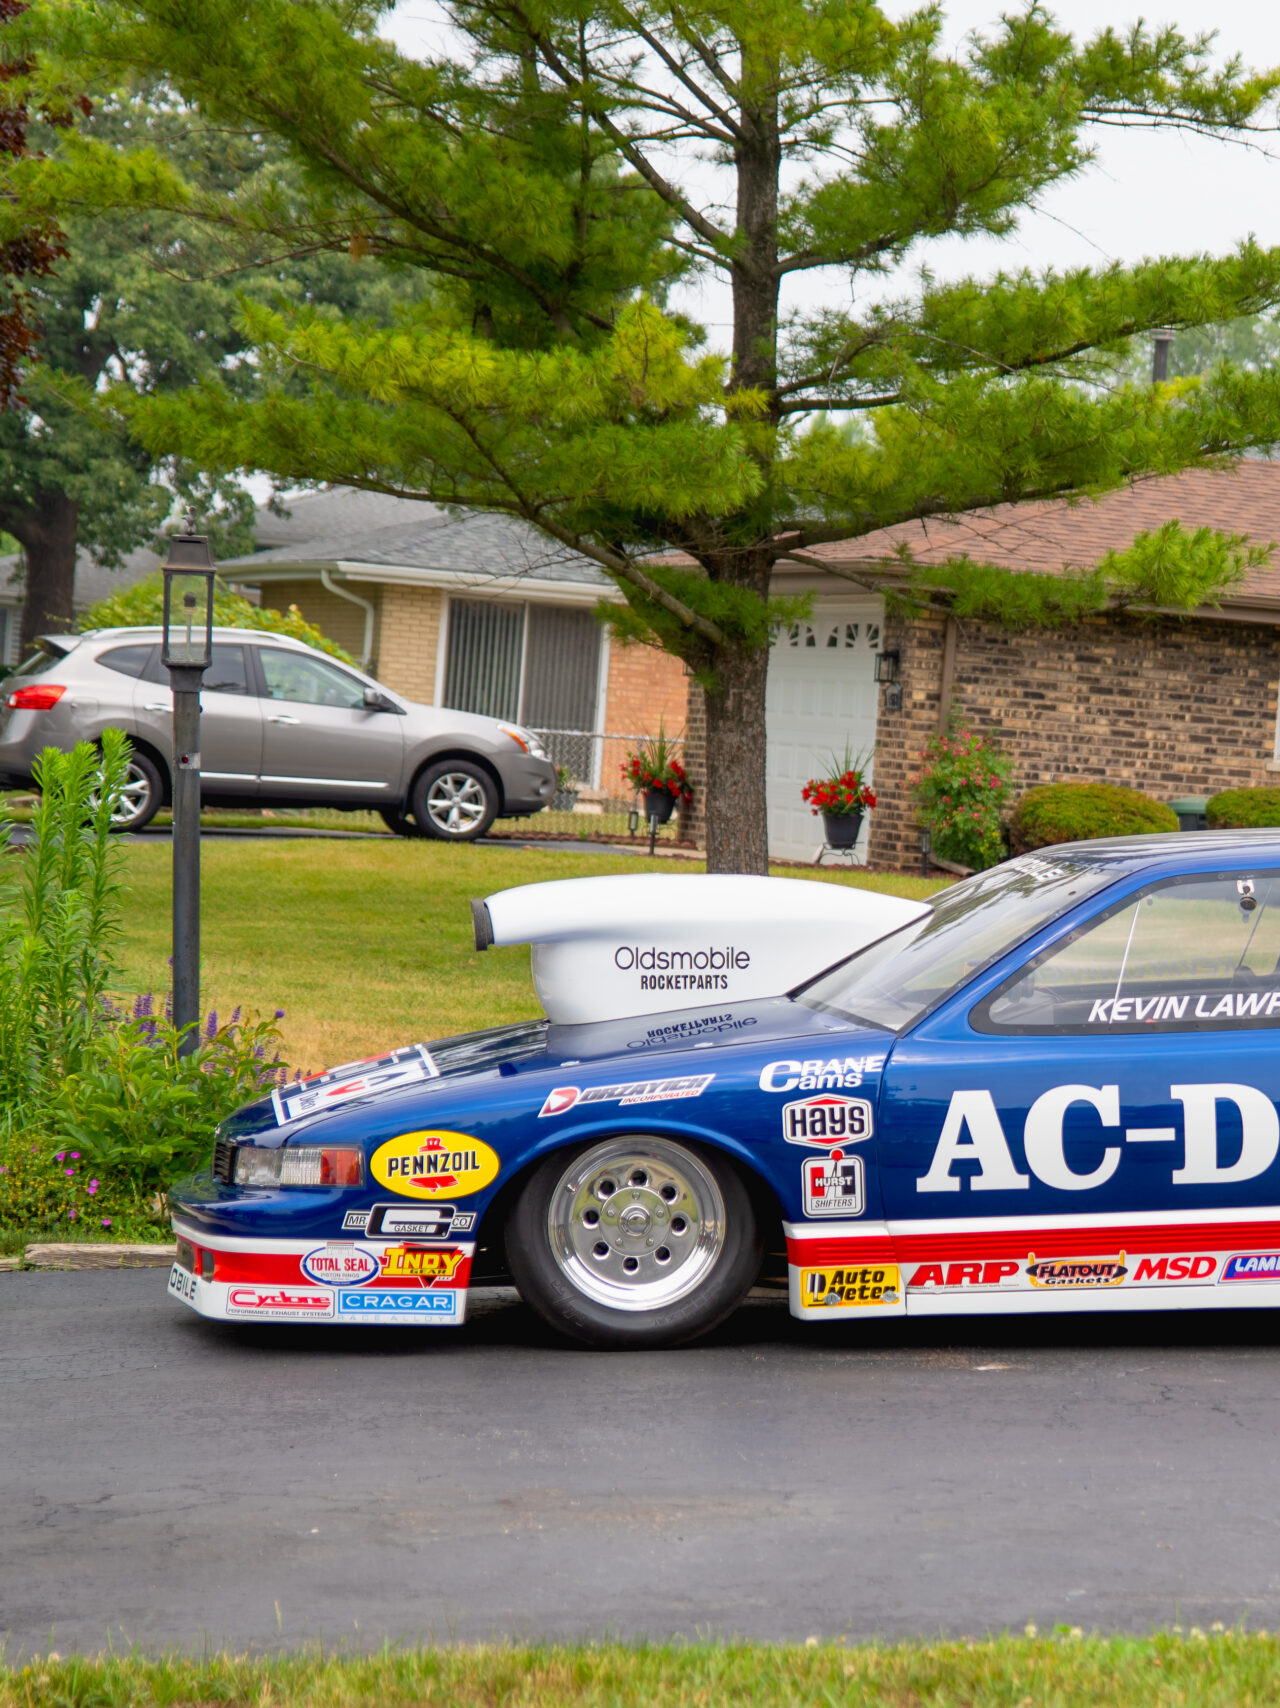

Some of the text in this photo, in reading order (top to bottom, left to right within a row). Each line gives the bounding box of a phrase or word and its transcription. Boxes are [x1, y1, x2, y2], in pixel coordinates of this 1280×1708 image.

[615, 946, 750, 970] Oldsmobile
[640, 974, 728, 990] ROCKETPARTS
[1088, 996, 1190, 1022] KEVIN
[622, 1090, 699, 1104] INCORPORATED
[387, 1151, 480, 1178] PENNZOIL
[815, 1176, 853, 1188] HURST
[814, 1199, 853, 1209] SHIFTERS
[349, 1215, 368, 1225] MR.
[393, 1224, 430, 1233] GASKET
[310, 1258, 371, 1272] TOTAL SEAL
[382, 1247, 463, 1276] INDY
[1133, 1257, 1217, 1281] MSD
[831, 1269, 885, 1286] Auto
[908, 1262, 1020, 1286] ARP
[1039, 1263, 1117, 1279] FLATOUT
[1044, 1276, 1111, 1285] Gaskets
[229, 1288, 332, 1310] Cyclone
[345, 1295, 447, 1309] CRAGAR
[228, 1308, 270, 1316] PERFORMANCE
